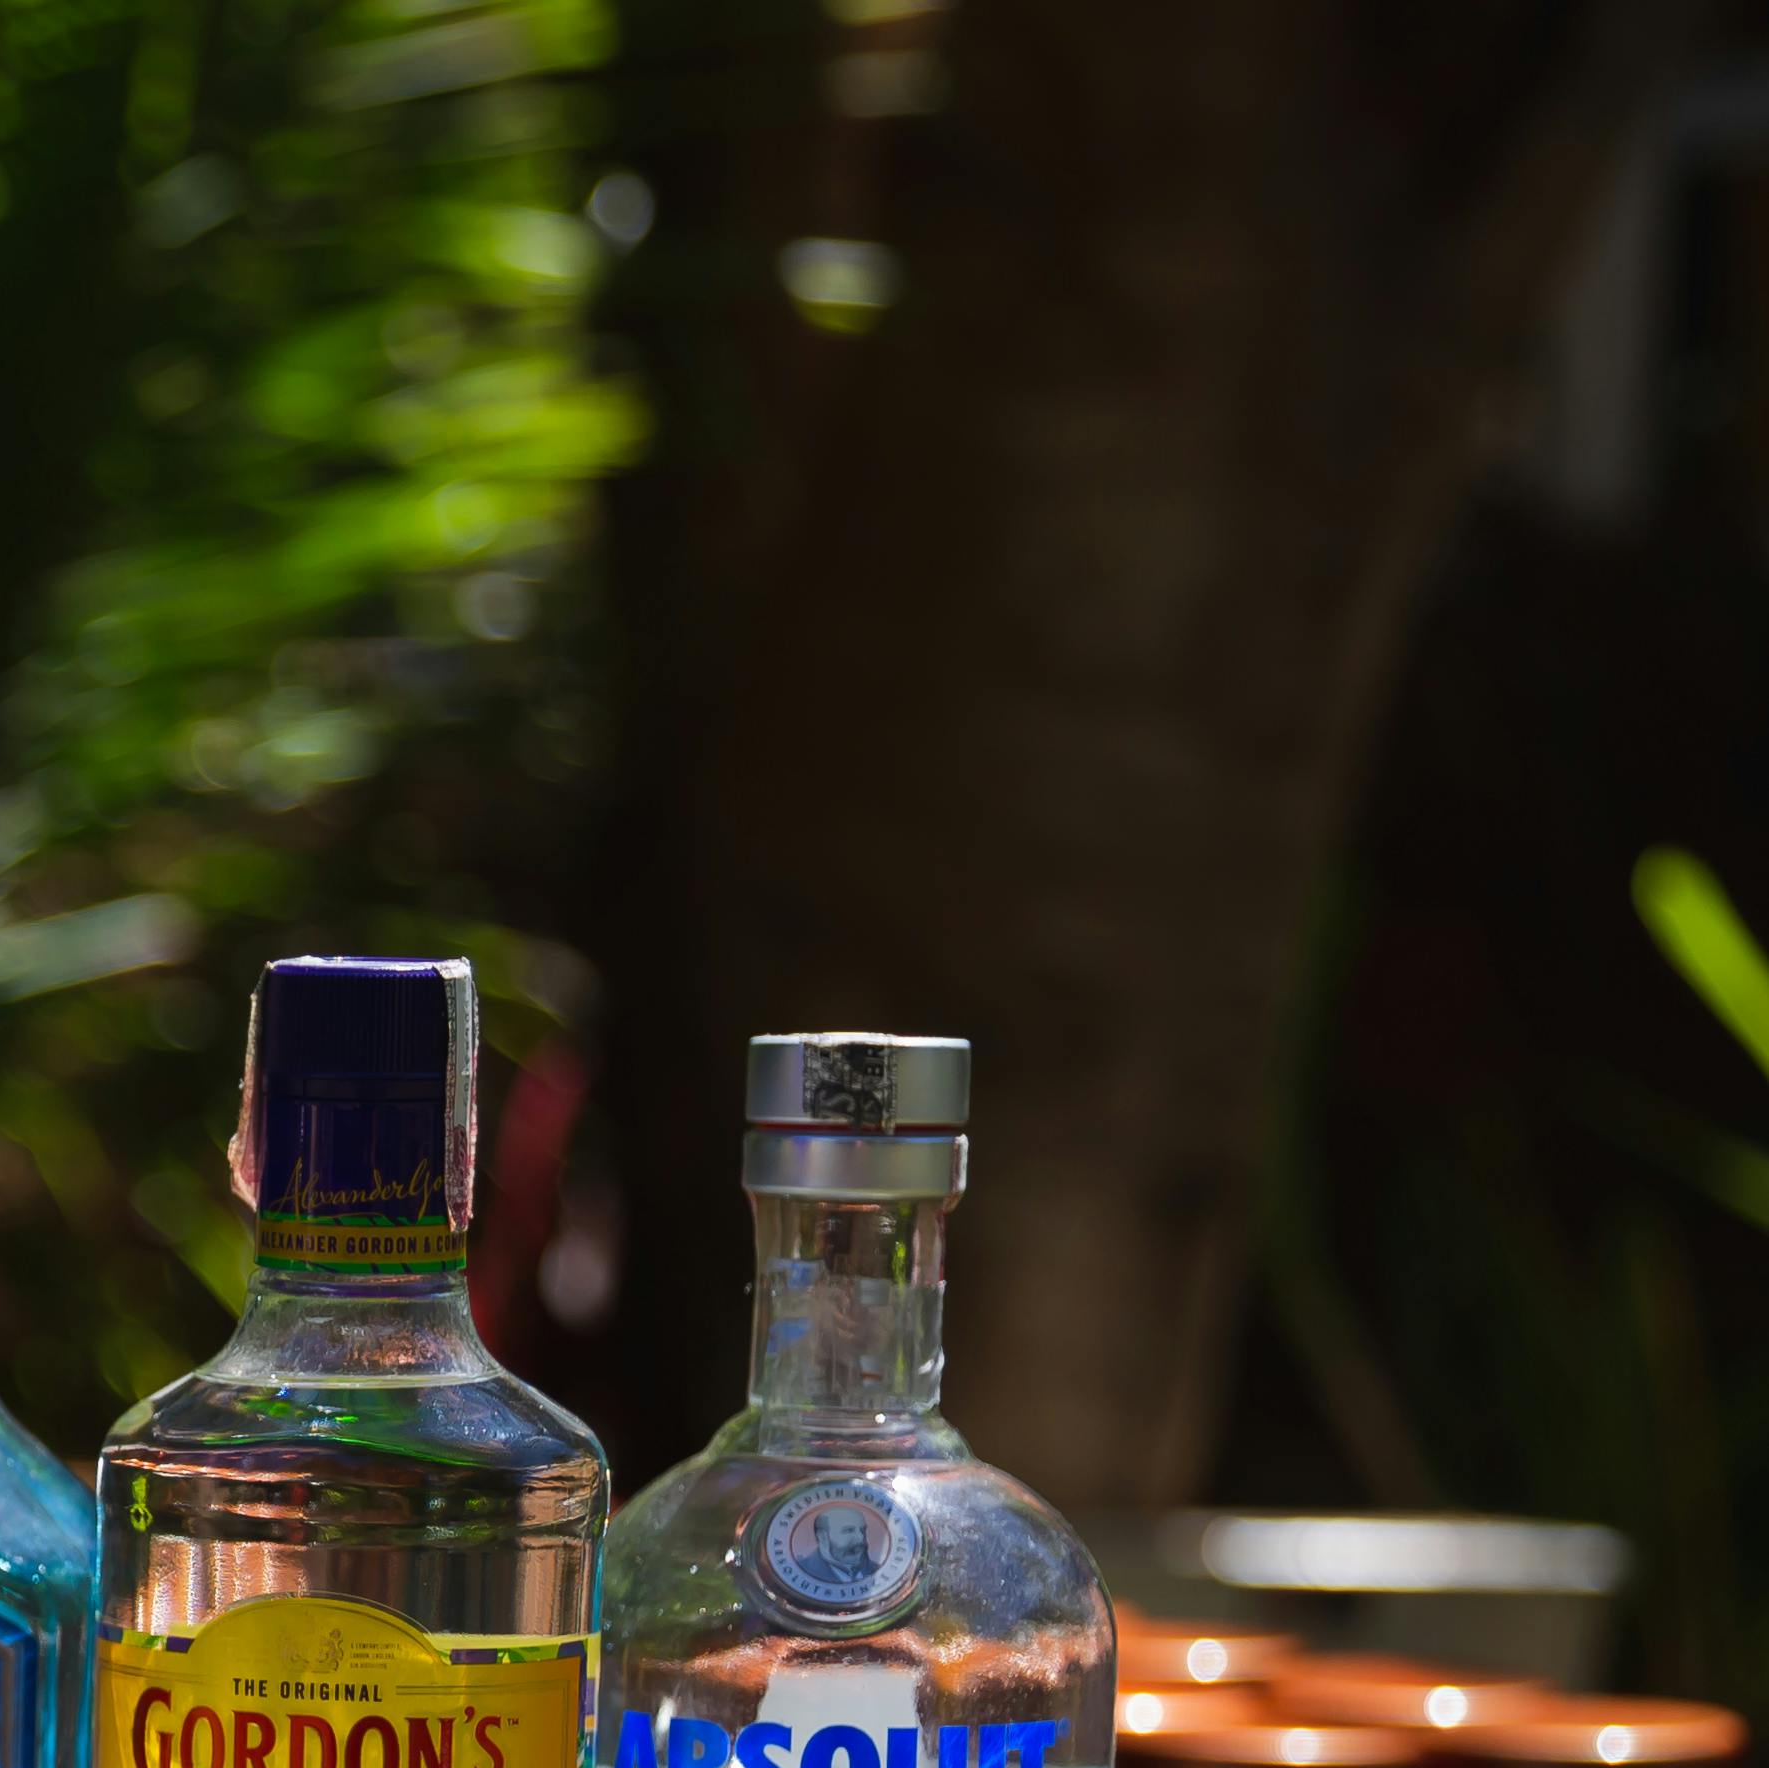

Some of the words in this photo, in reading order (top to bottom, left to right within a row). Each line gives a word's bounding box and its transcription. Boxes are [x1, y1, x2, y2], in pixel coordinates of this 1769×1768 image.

[346, 1235, 417, 1255] GORDON
[423, 1235, 431, 1254] &
[232, 1677, 268, 1698] THE
[280, 1679, 383, 1703] ORIGINAL
